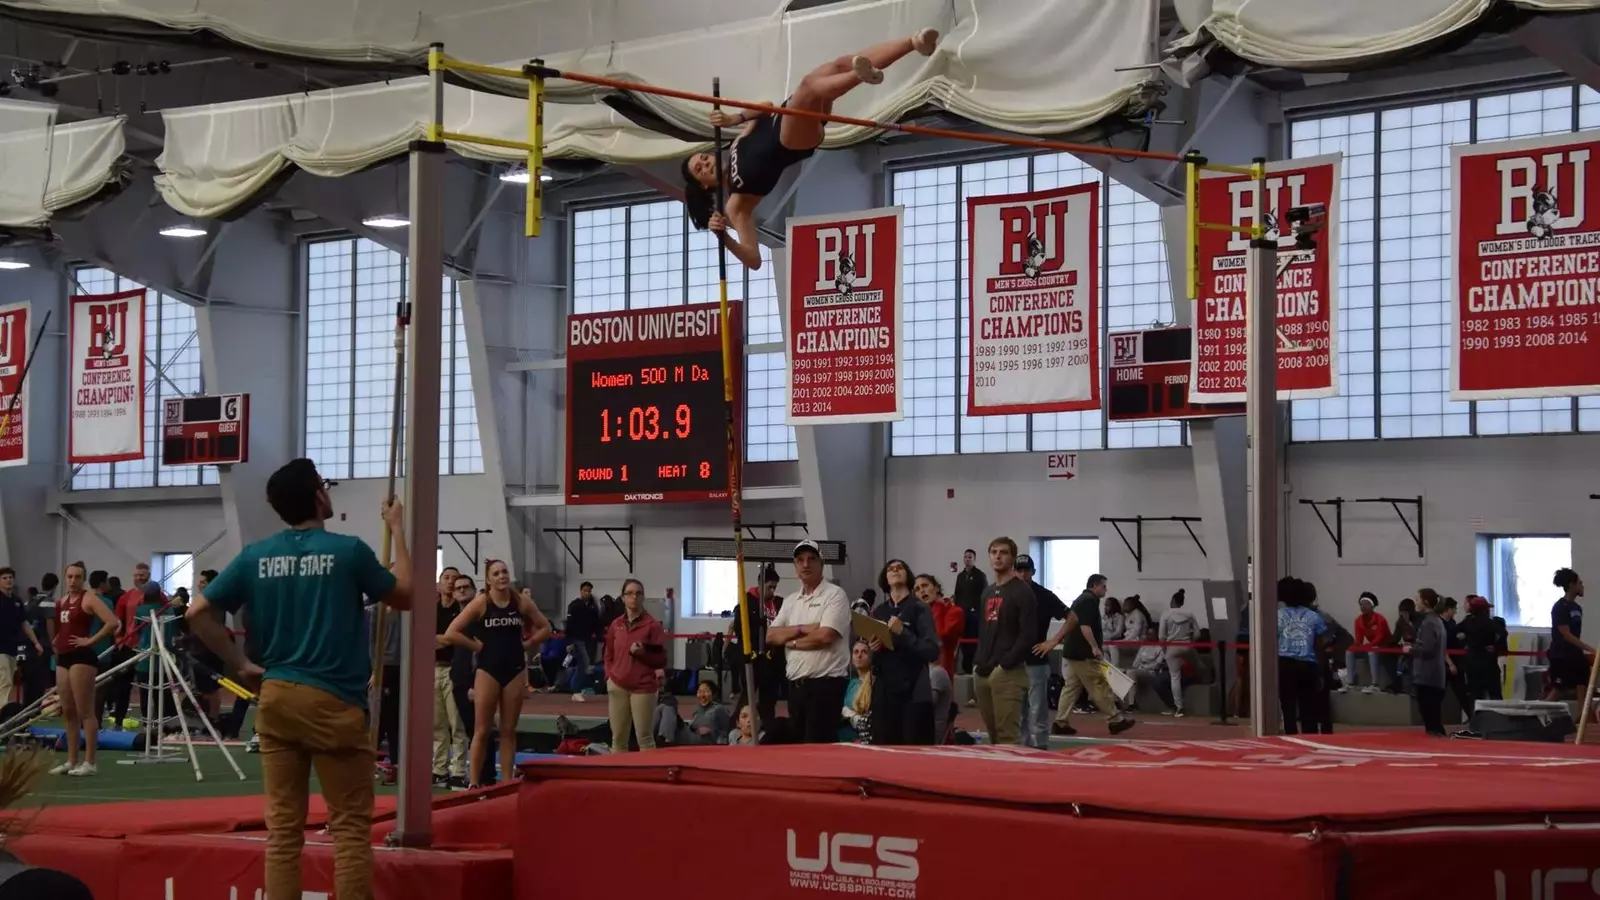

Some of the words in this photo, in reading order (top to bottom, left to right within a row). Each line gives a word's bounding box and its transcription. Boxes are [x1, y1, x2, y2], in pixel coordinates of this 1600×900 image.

[1496, 149, 1590, 235] BU
[999, 200, 1068, 276] BU
[1481, 239, 1522, 254] WOMEN'S
[1524, 235, 1566, 251] OUTDOOR
[1568, 232, 1600, 247] TRACK
[815, 223, 876, 291] BU
[1481, 252, 1599, 282] CONFERENCE
[994, 278, 1017, 290] MEN'S
[1017, 276, 1037, 288] CROSS
[1038, 274, 1069, 286] COUNTRY
[805, 295, 834, 306] WOMEN'S
[835, 293, 853, 304] CROSS
[853, 291, 881, 302] COUNTRY
[989, 289, 1074, 314] CONFERENCE
[1205, 290, 1319, 322] CHAIONS
[805, 306, 881, 328] CONFERENCE
[980, 310, 1083, 340] CHAMPIONS
[1462, 319, 1489, 333] 1982
[1494, 317, 1521, 331] 1983
[1526, 315, 1554, 329] 1984
[1559, 313, 1588, 327] 1985
[88, 302, 128, 357] BU
[571, 315, 634, 346] BOSTON
[1198, 328, 1221, 340] 1980
[1279, 322, 1302, 335] 1988
[1305, 320, 1329, 333] 1990
[796, 326, 890, 354] CHAMPIONS
[975, 345, 996, 357] 1989
[999, 344, 1020, 356] 1990
[1022, 342, 1043, 354] 1991
[1046, 341, 1066, 352] 1992
[1113, 336, 1137, 361] BU
[1462, 336, 1489, 350] 1990
[1494, 335, 1521, 348] 1993
[1525, 333, 1554, 347] 2008
[1558, 331, 1588, 345] 2014
[1199, 344, 1220, 356] 1991
[792, 359, 811, 369] 1990
[813, 357, 832, 368] 1991
[834, 356, 853, 367] 1992
[854, 355, 874, 366] 1993
[875, 353, 894, 364] 1994
[975, 361, 996, 372] 1994
[999, 359, 1020, 370] 1995
[1022, 358, 1043, 369] 1996
[1046, 356, 1064, 368] 1997
[1199, 361, 1220, 372] 2002
[1278, 356, 1302, 369] 2008
[1305, 354, 1329, 367] 2009
[82, 369, 131, 386] CONFERENCE
[591, 371, 633, 388] Women
[641, 367, 667, 385] 500
[674, 366, 684, 382] M
[691, 364, 710, 382] Da
[792, 373, 811, 384] 1996
[813, 372, 832, 383] 1997
[834, 371, 853, 382] 1998
[854, 369, 874, 381] 1999
[875, 368, 894, 379] 2000
[975, 376, 996, 387] 2010
[1116, 367, 1144, 381] HOME
[1164, 374, 1188, 385] PERIOD
[1199, 377, 1220, 389] 2012
[1224, 376, 1247, 388] 2014
[792, 388, 811, 399] 2001
[812, 387, 832, 398] 2002
[834, 385, 853, 396] 2004
[854, 384, 874, 395] 2005
[875, 383, 894, 394] 2006
[166, 402, 181, 420] BU
[792, 402, 811, 413] 2013
[812, 401, 832, 412] 2014
[218, 422, 237, 433] GUEST
[600, 404, 691, 442] 1:03.9
[1048, 454, 1076, 468] EXIT
[578, 467, 613, 480] ROUND
[620, 465, 628, 481] 1
[658, 465, 688, 478] HEAT
[699, 461, 711, 478] 8
[624, 493, 663, 501] DAKTRONICS
[258, 556, 297, 578] EVENT
[299, 554, 335, 577] STAFF
[786, 828, 920, 882] UCS
[790, 870, 811, 880] MADE
[789, 878, 916, 899] WWW.UCSSPIRIT.COM
